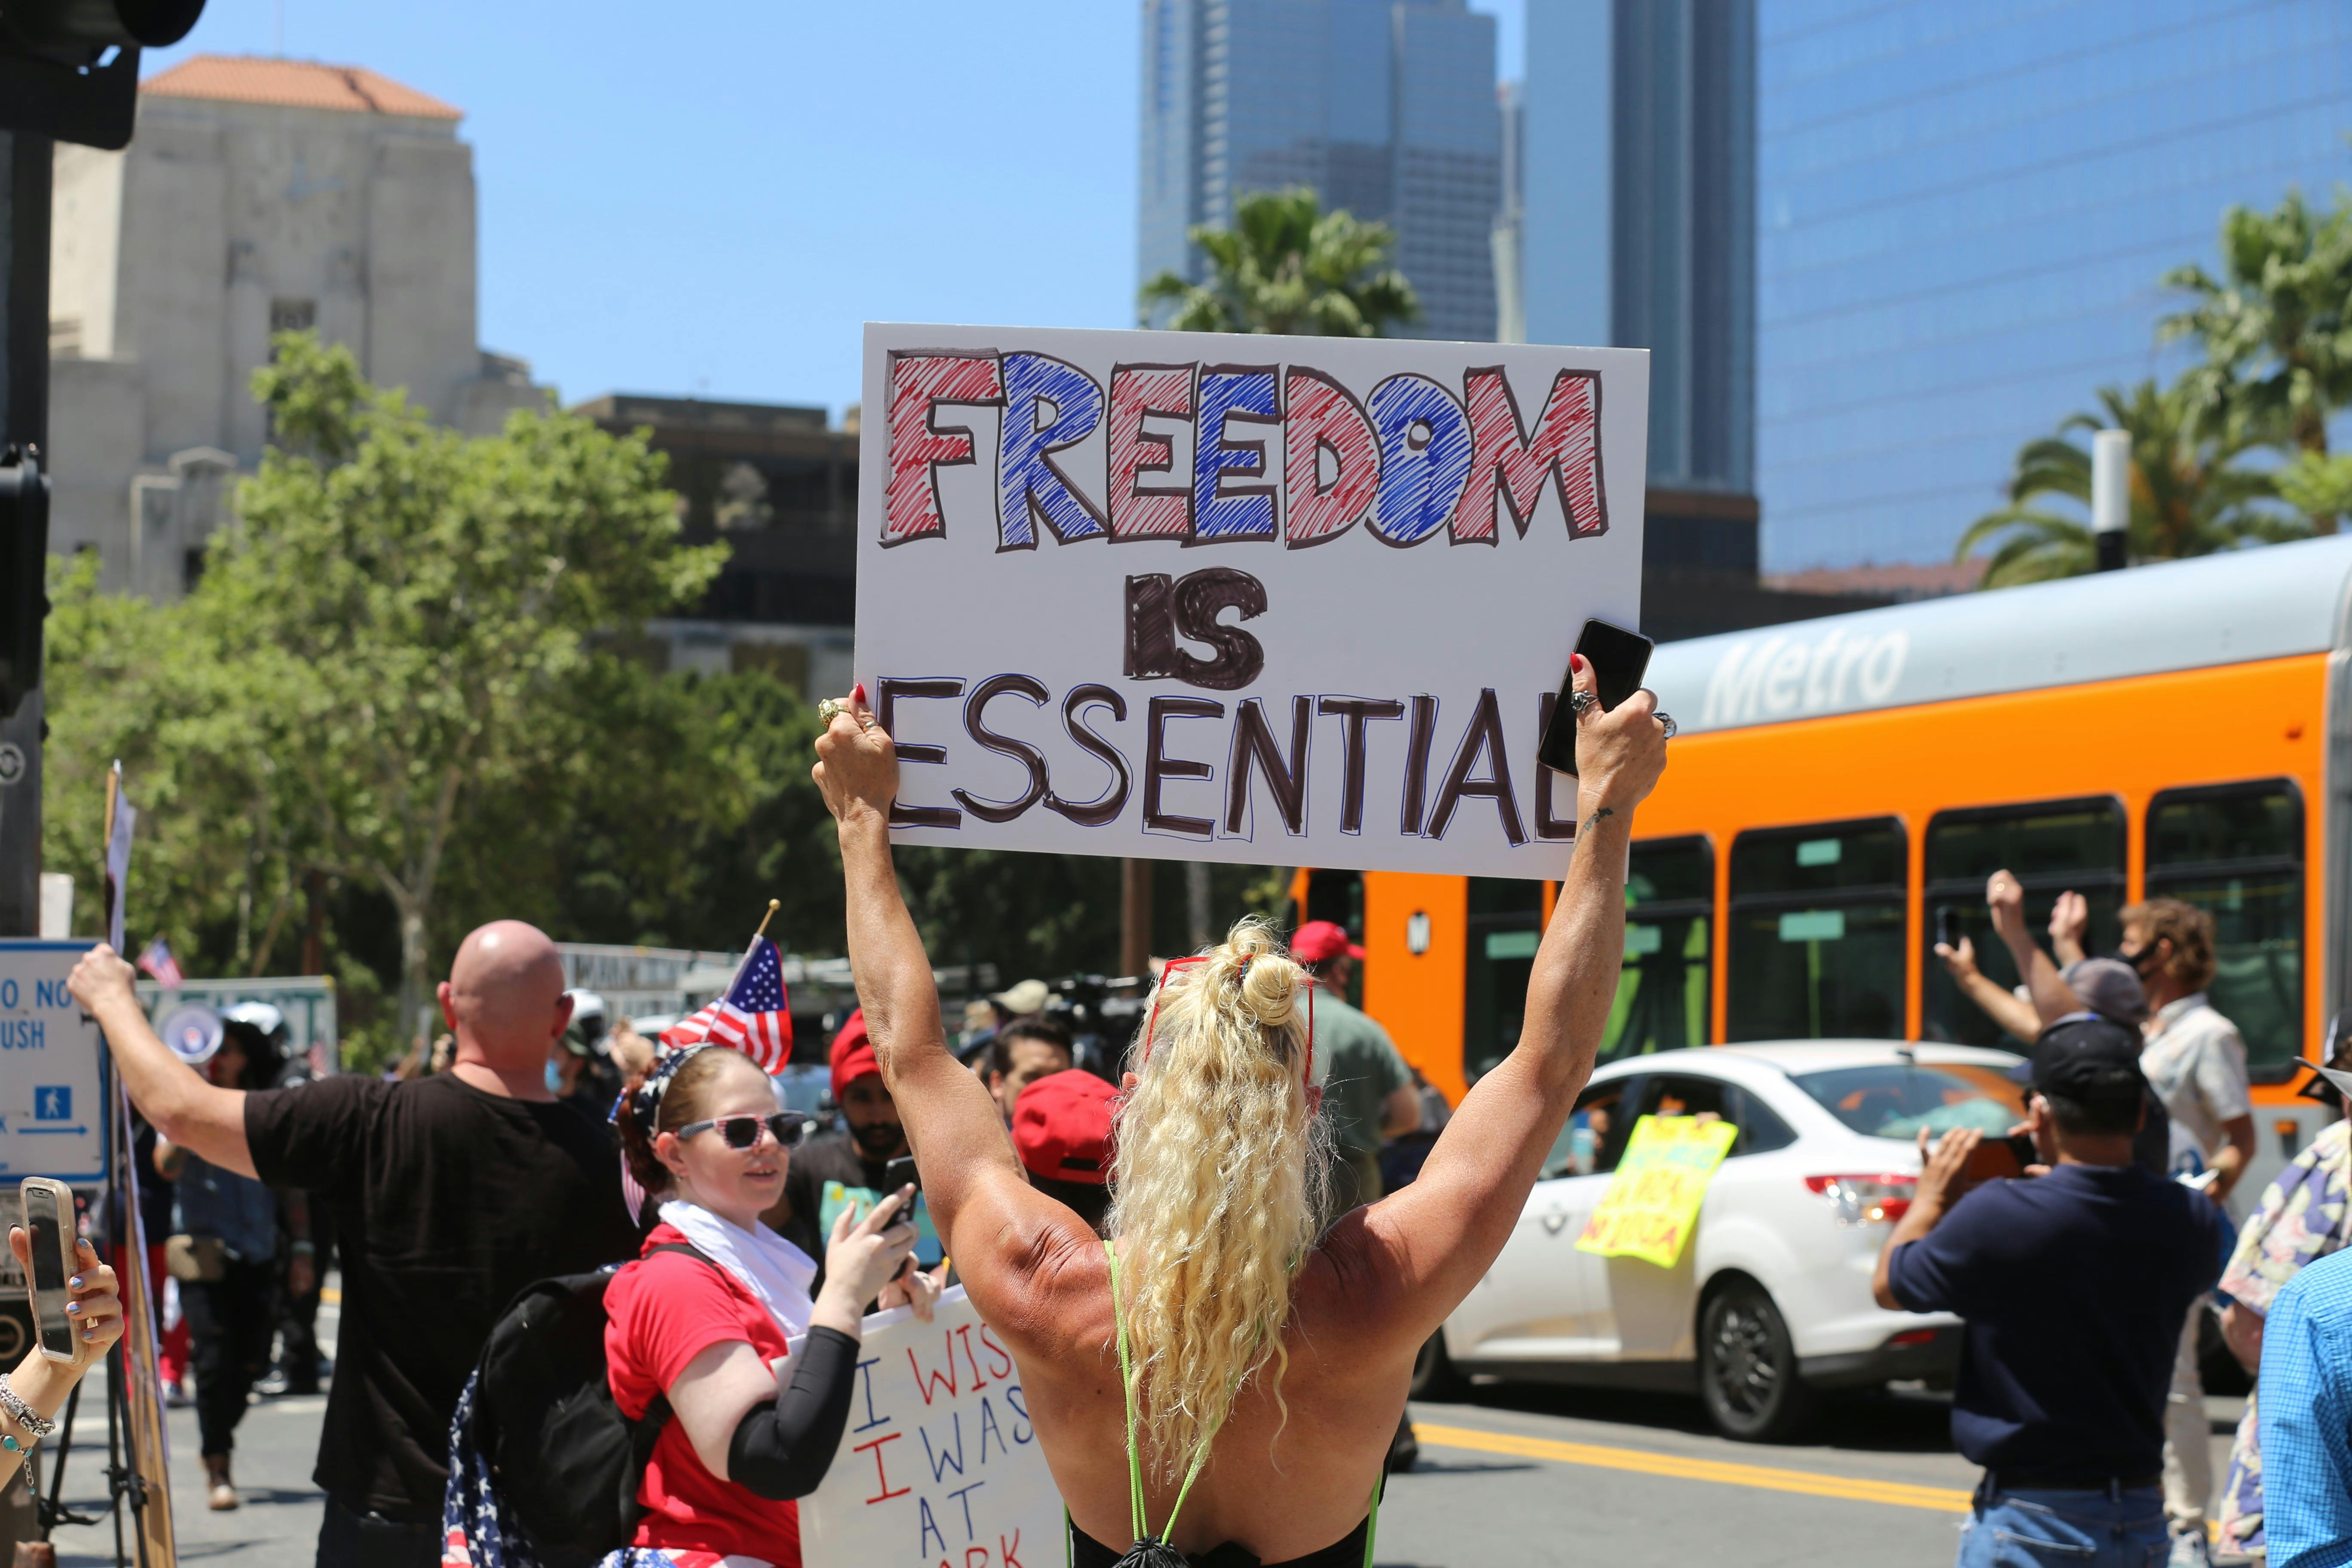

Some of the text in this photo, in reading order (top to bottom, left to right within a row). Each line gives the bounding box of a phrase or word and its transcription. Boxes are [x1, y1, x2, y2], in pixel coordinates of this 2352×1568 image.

[877, 347, 1610, 554] FREEDOM
[1123, 565, 1268, 690] IS
[1701, 629, 1909, 726] Metro
[876, 673, 1577, 847] ESSENTIAL
[1, 1020, 45, 1050] USH
[36, 979, 73, 1008] NO
[853, 1322, 1011, 1433] I WIS
[853, 1385, 1033, 1504] I WAS
[919, 1481, 986, 1559] AT
